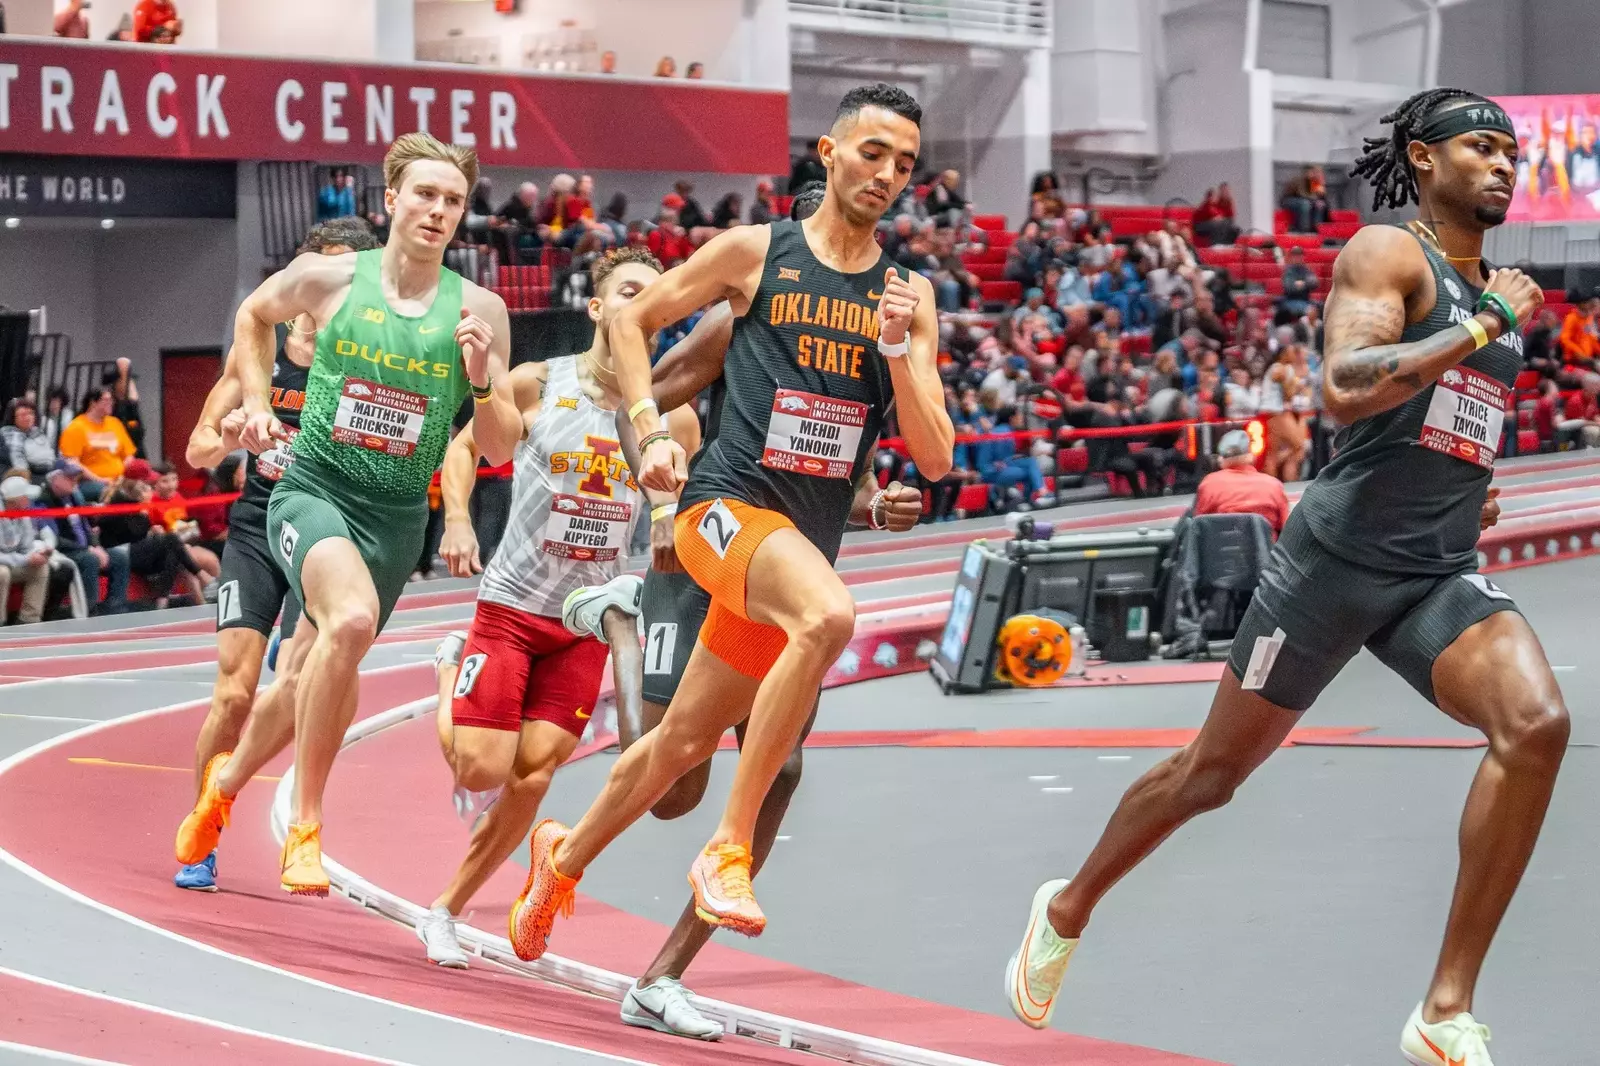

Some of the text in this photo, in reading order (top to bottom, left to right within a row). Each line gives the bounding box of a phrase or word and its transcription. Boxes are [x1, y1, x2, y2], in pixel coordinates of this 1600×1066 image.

[0, 63, 518, 150] TRACK CENTER
[42, 175, 126, 203] WORLD
[770, 292, 882, 342] OKLAHOM
[335, 339, 451, 378] DUCKS
[797, 334, 865, 379] STATE
[376, 387, 420, 404] RAZORBACK
[1466, 385, 1505, 409] INVITATIONAL
[1467, 374, 1501, 397] RAZORBACK
[353, 401, 410, 425] MATTHEW
[375, 395, 425, 412] INVITATIONAL
[814, 400, 859, 415] RAZORBACK
[1456, 395, 1488, 423] TYRICE
[350, 415, 405, 438] ERICKSON
[812, 409, 865, 425] INVITATIONAL
[1452, 414, 1488, 443] TAYLOR
[799, 419, 841, 441] MEHDI
[789, 435, 842, 458] YANOURI
[582, 509, 629, 520] INVITATIONAL
[583, 501, 625, 513] RAZORBACK
[569, 516, 609, 534] DARIUS
[703, 510, 735, 552] 2
[281, 530, 293, 557] 6
[563, 530, 609, 547] KIPYEGO
[653, 625, 667, 671] 1
[458, 656, 478, 694] 3
